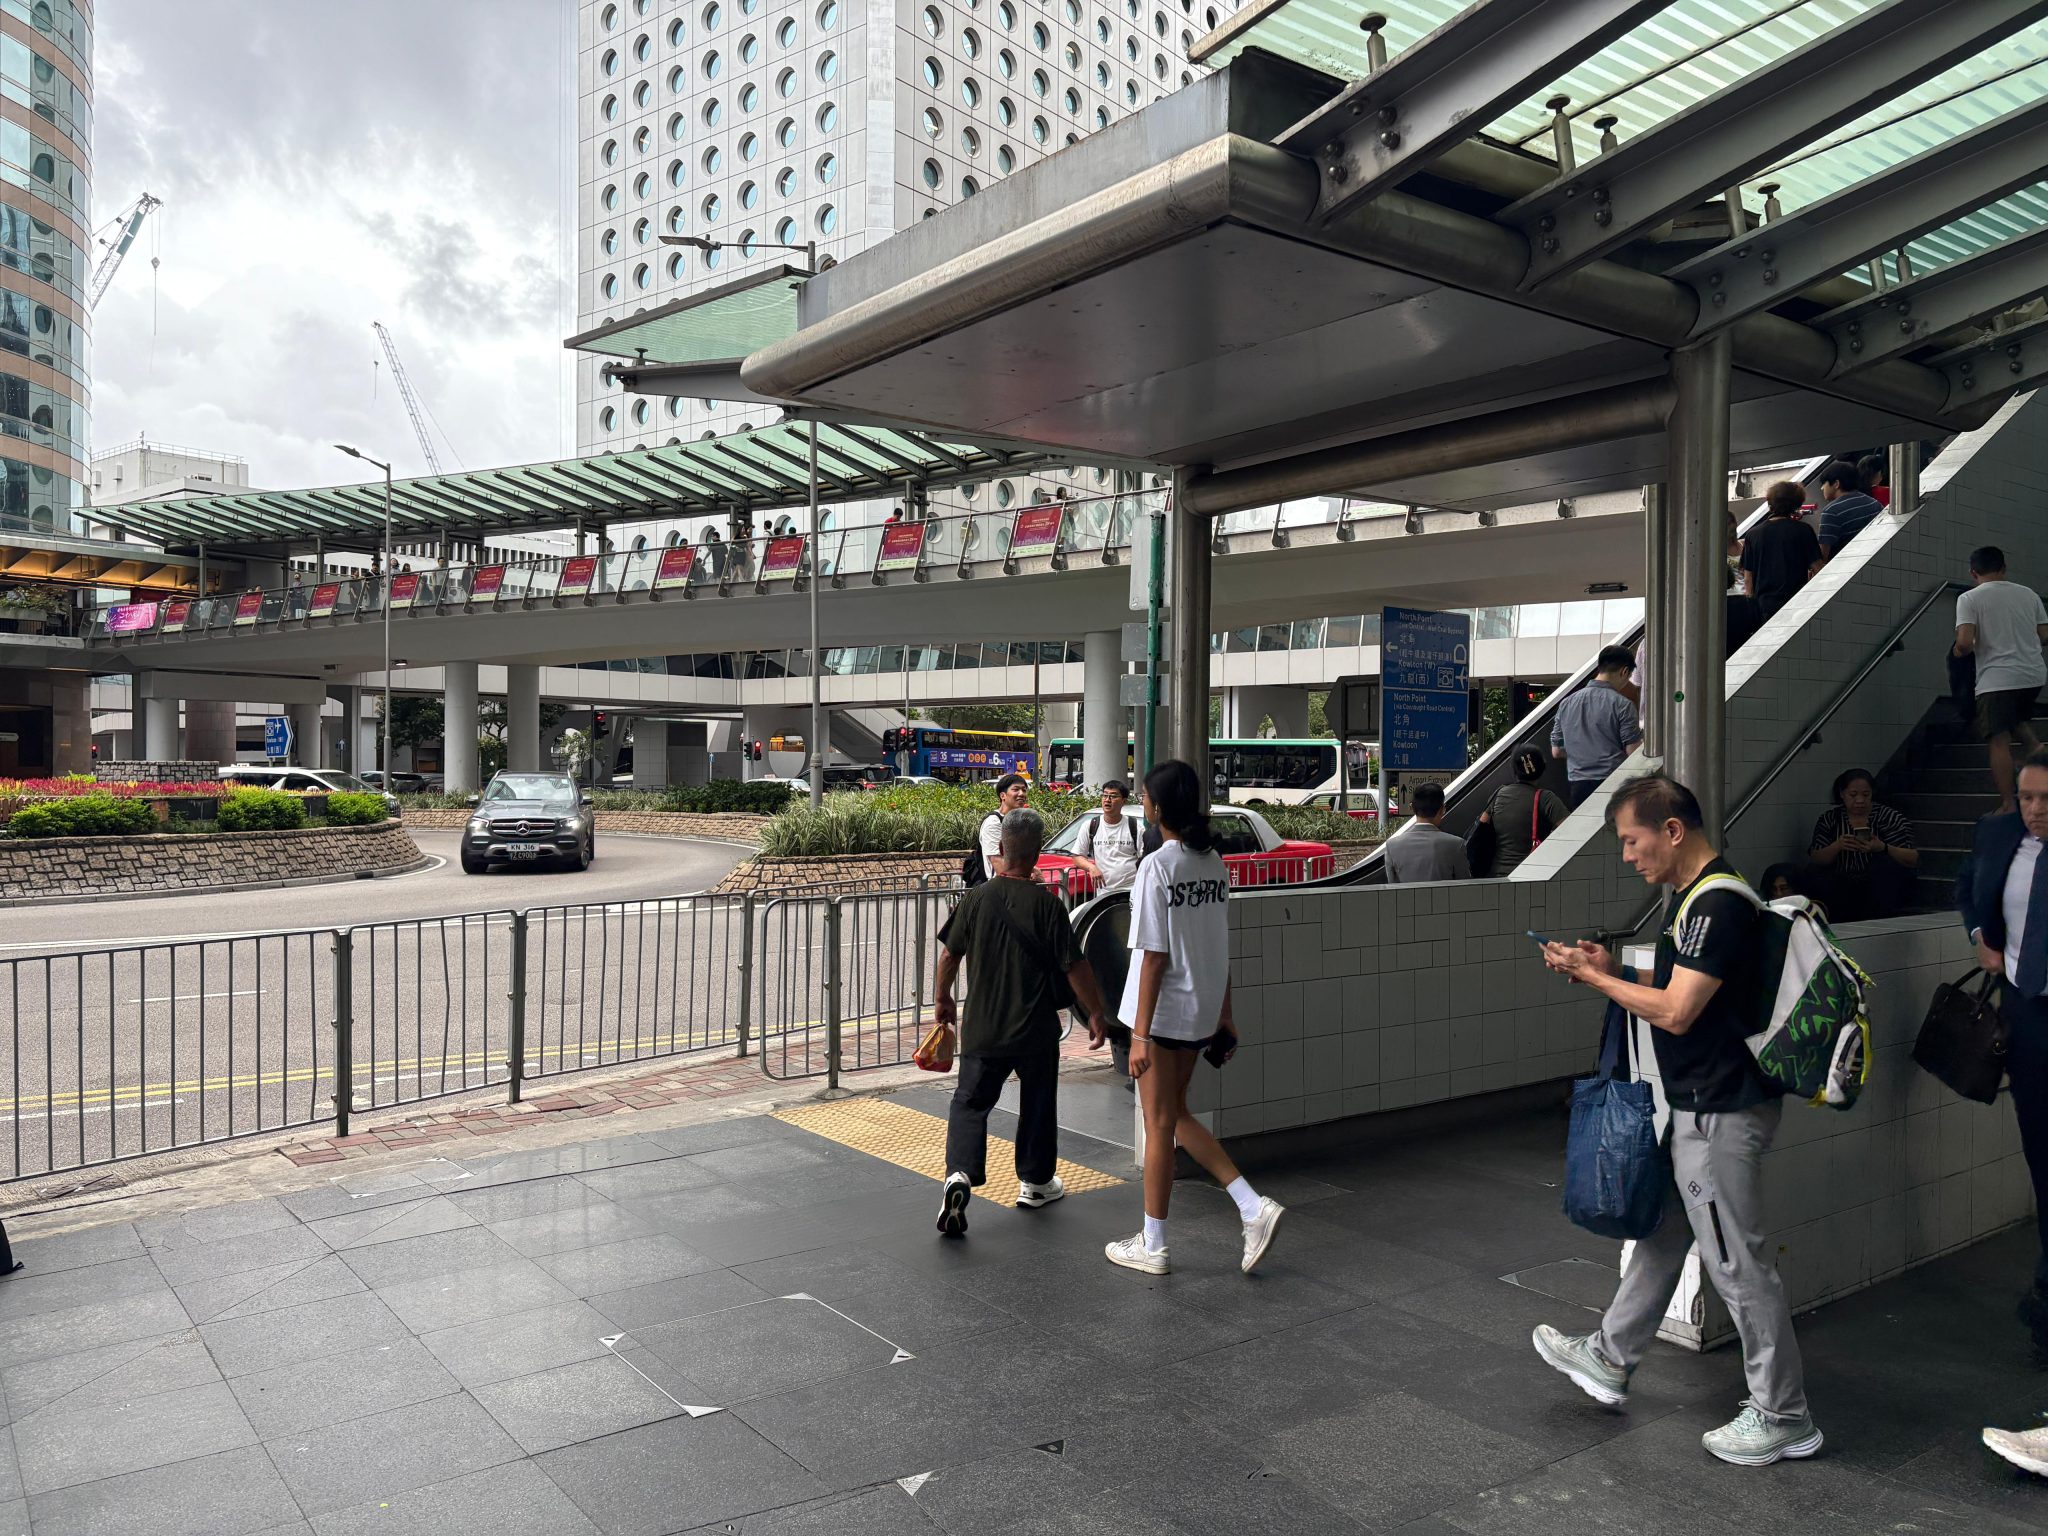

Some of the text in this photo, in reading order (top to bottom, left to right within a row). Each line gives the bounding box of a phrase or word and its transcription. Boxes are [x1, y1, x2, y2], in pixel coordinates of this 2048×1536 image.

[1400, 612, 1432, 623] North Point
[1400, 633, 1415, 645] 北角
[1399, 660, 1436, 670] Kowloon (W)
[1393, 693, 1426, 703] North Point
[1394, 714, 1410, 726] 北角
[1392, 740, 1418, 749] Kowloon
